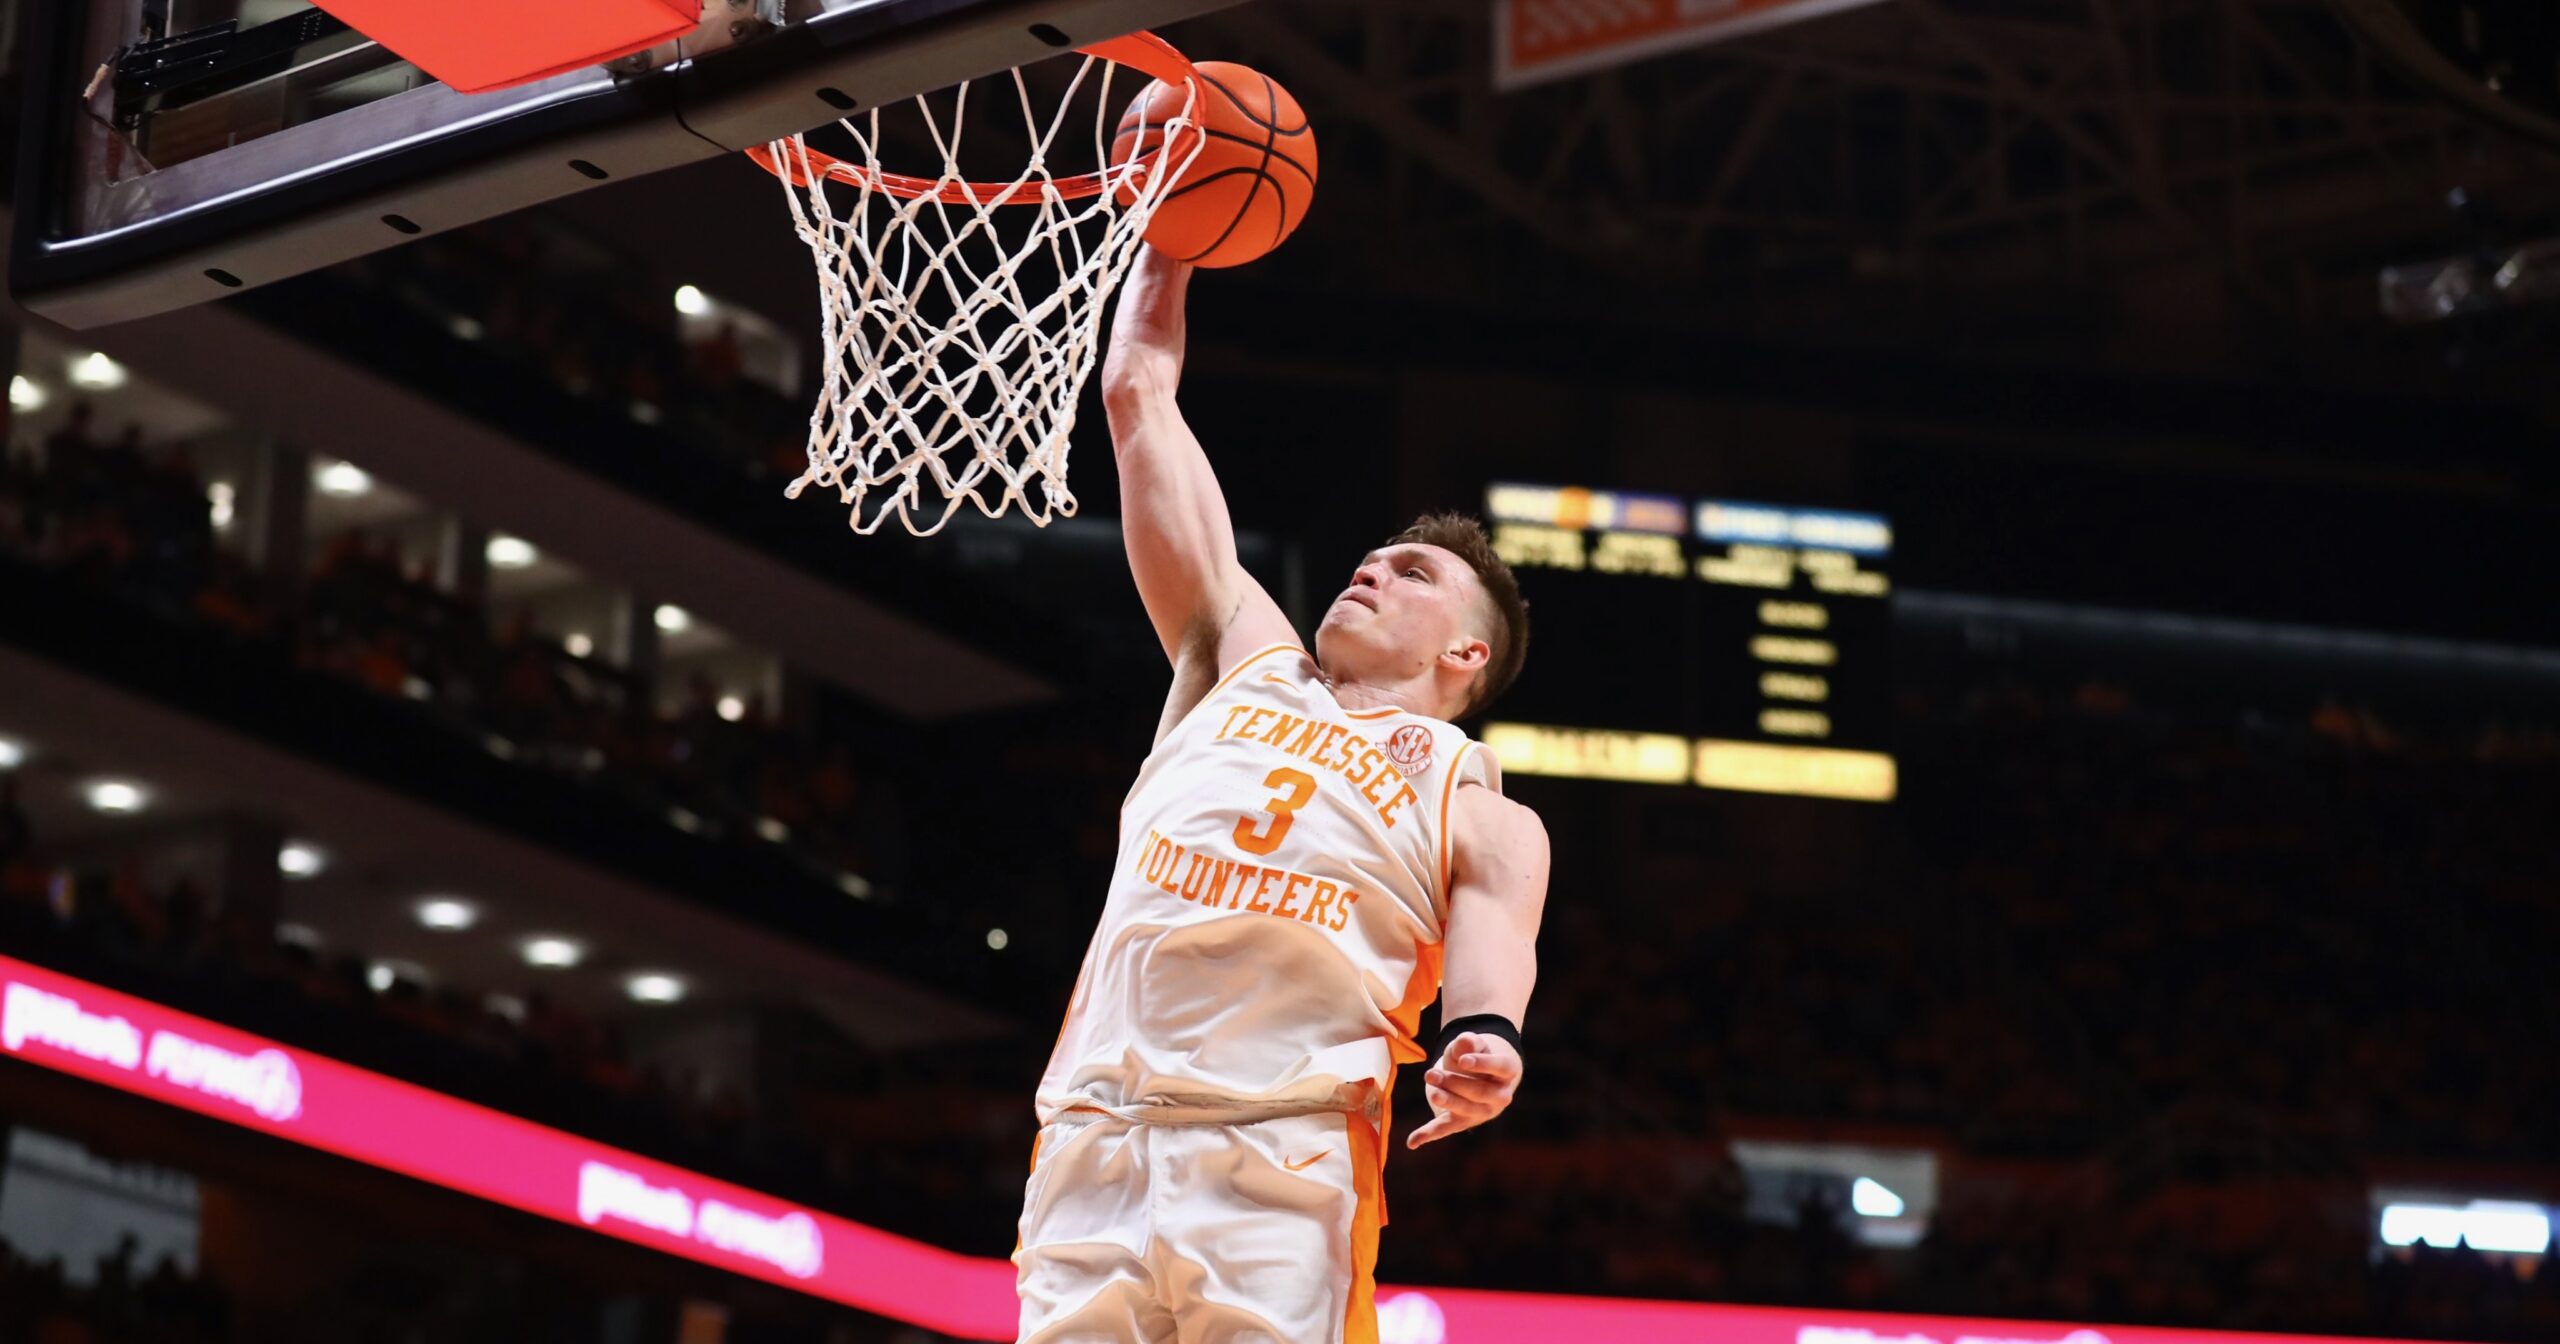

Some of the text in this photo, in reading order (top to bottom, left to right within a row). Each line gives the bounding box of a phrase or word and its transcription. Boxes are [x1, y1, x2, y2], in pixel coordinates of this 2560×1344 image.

[1216, 705, 1418, 829] TENNESSEE
[1390, 726, 1431, 763] SEC
[1232, 767, 1317, 856] 3
[1136, 831, 1360, 932] VOLUNTEERS
